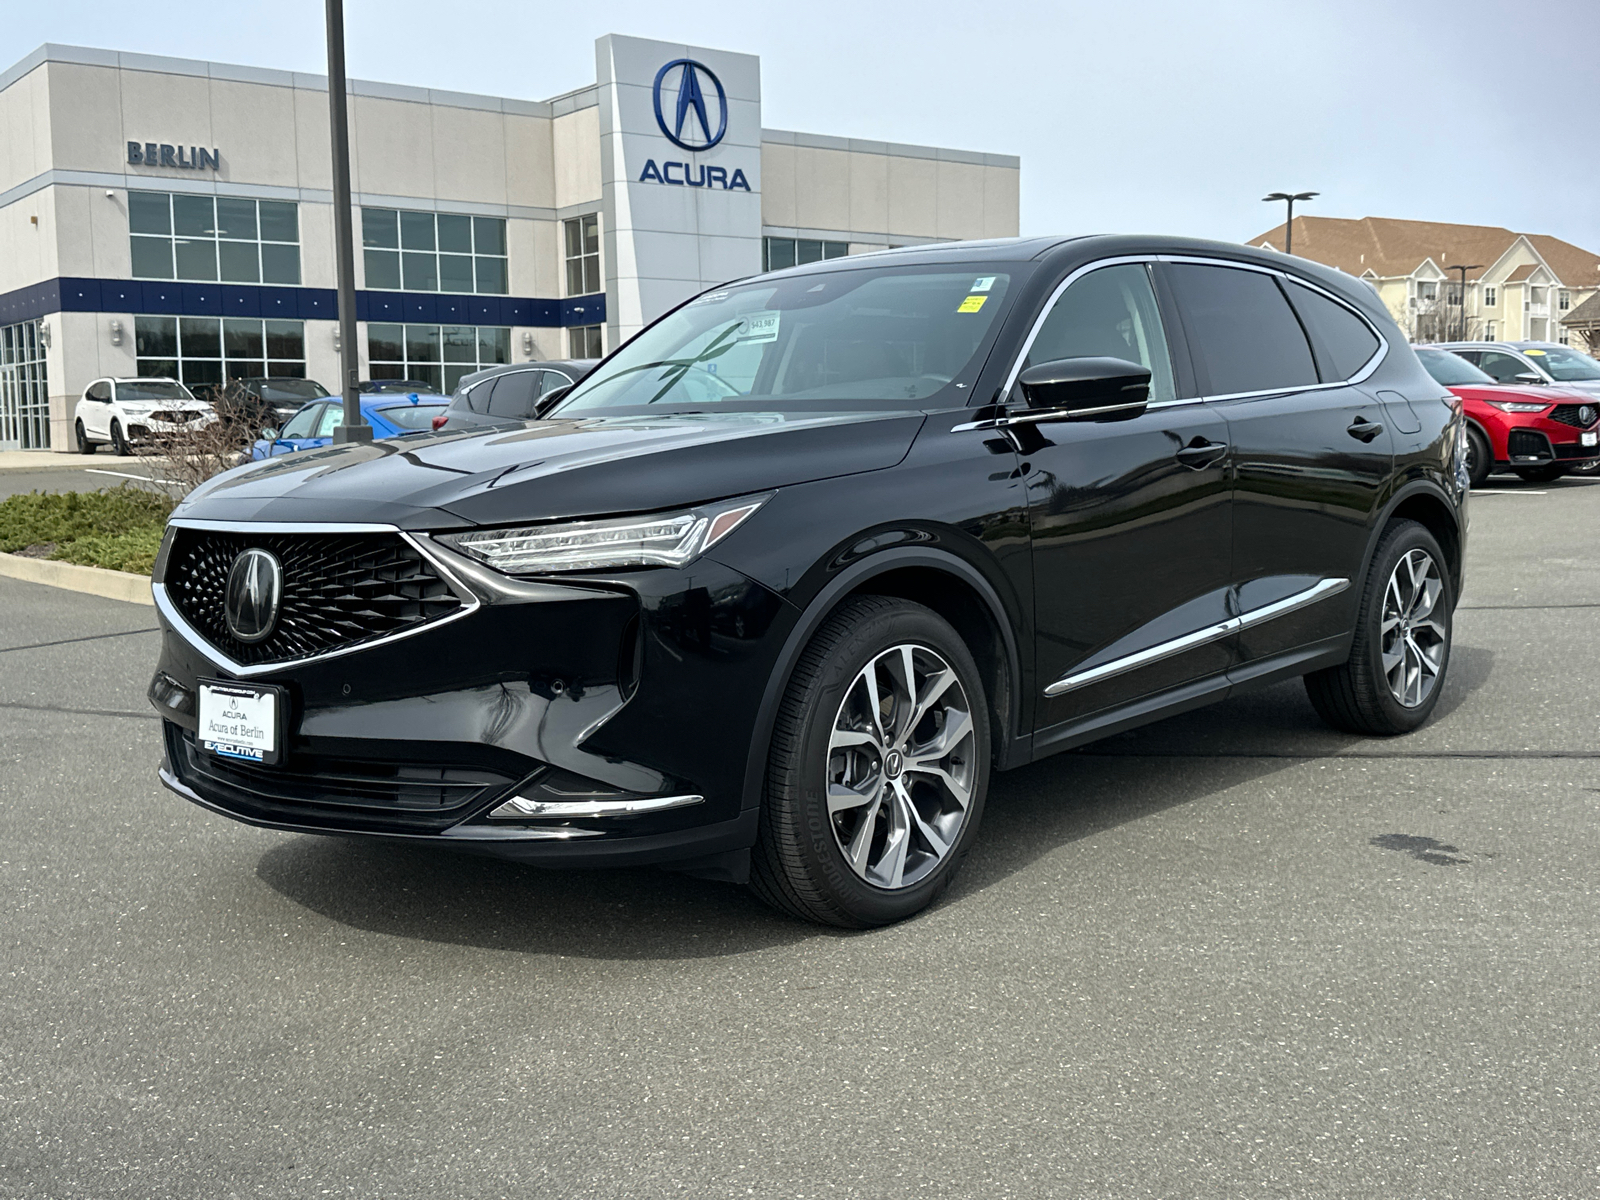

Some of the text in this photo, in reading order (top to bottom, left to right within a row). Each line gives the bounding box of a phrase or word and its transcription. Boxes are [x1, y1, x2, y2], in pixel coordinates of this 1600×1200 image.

[127, 141, 219, 170] BERLIN
[639, 159, 751, 191] ACURA
[222, 710, 247, 720] ACURA
[209, 719, 264, 739] Acura of Berlin
[204, 741, 263, 758] EXECUTIVE
